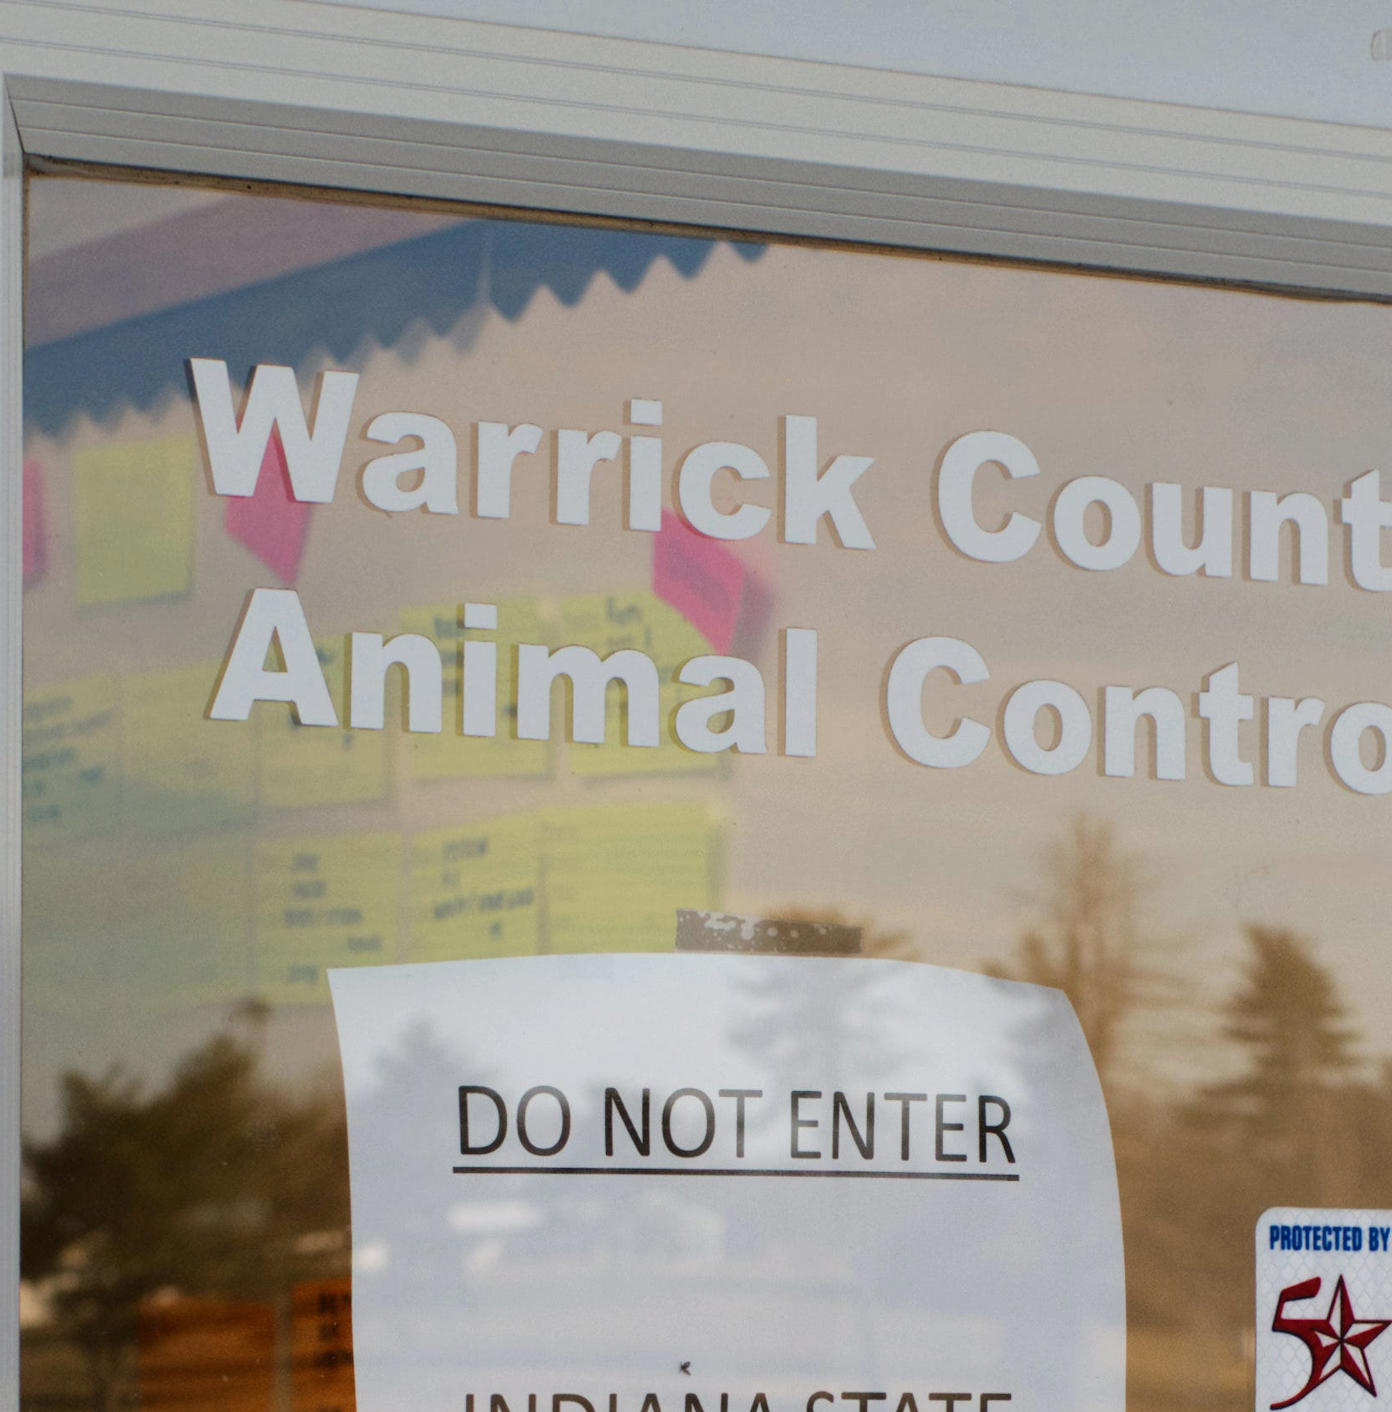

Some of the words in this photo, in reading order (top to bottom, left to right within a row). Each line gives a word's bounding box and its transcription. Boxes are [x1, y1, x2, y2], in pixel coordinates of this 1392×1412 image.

[190, 356, 877, 551] Warrick
[208, 586, 819, 759] Animal
[458, 1085, 571, 1157] DO
[604, 1087, 763, 1158] NOT
[789, 1090, 1016, 1164] ENTER
[1269, 1225, 1362, 1252] PROTECTED
[1368, 1226, 1391, 1252] BY
